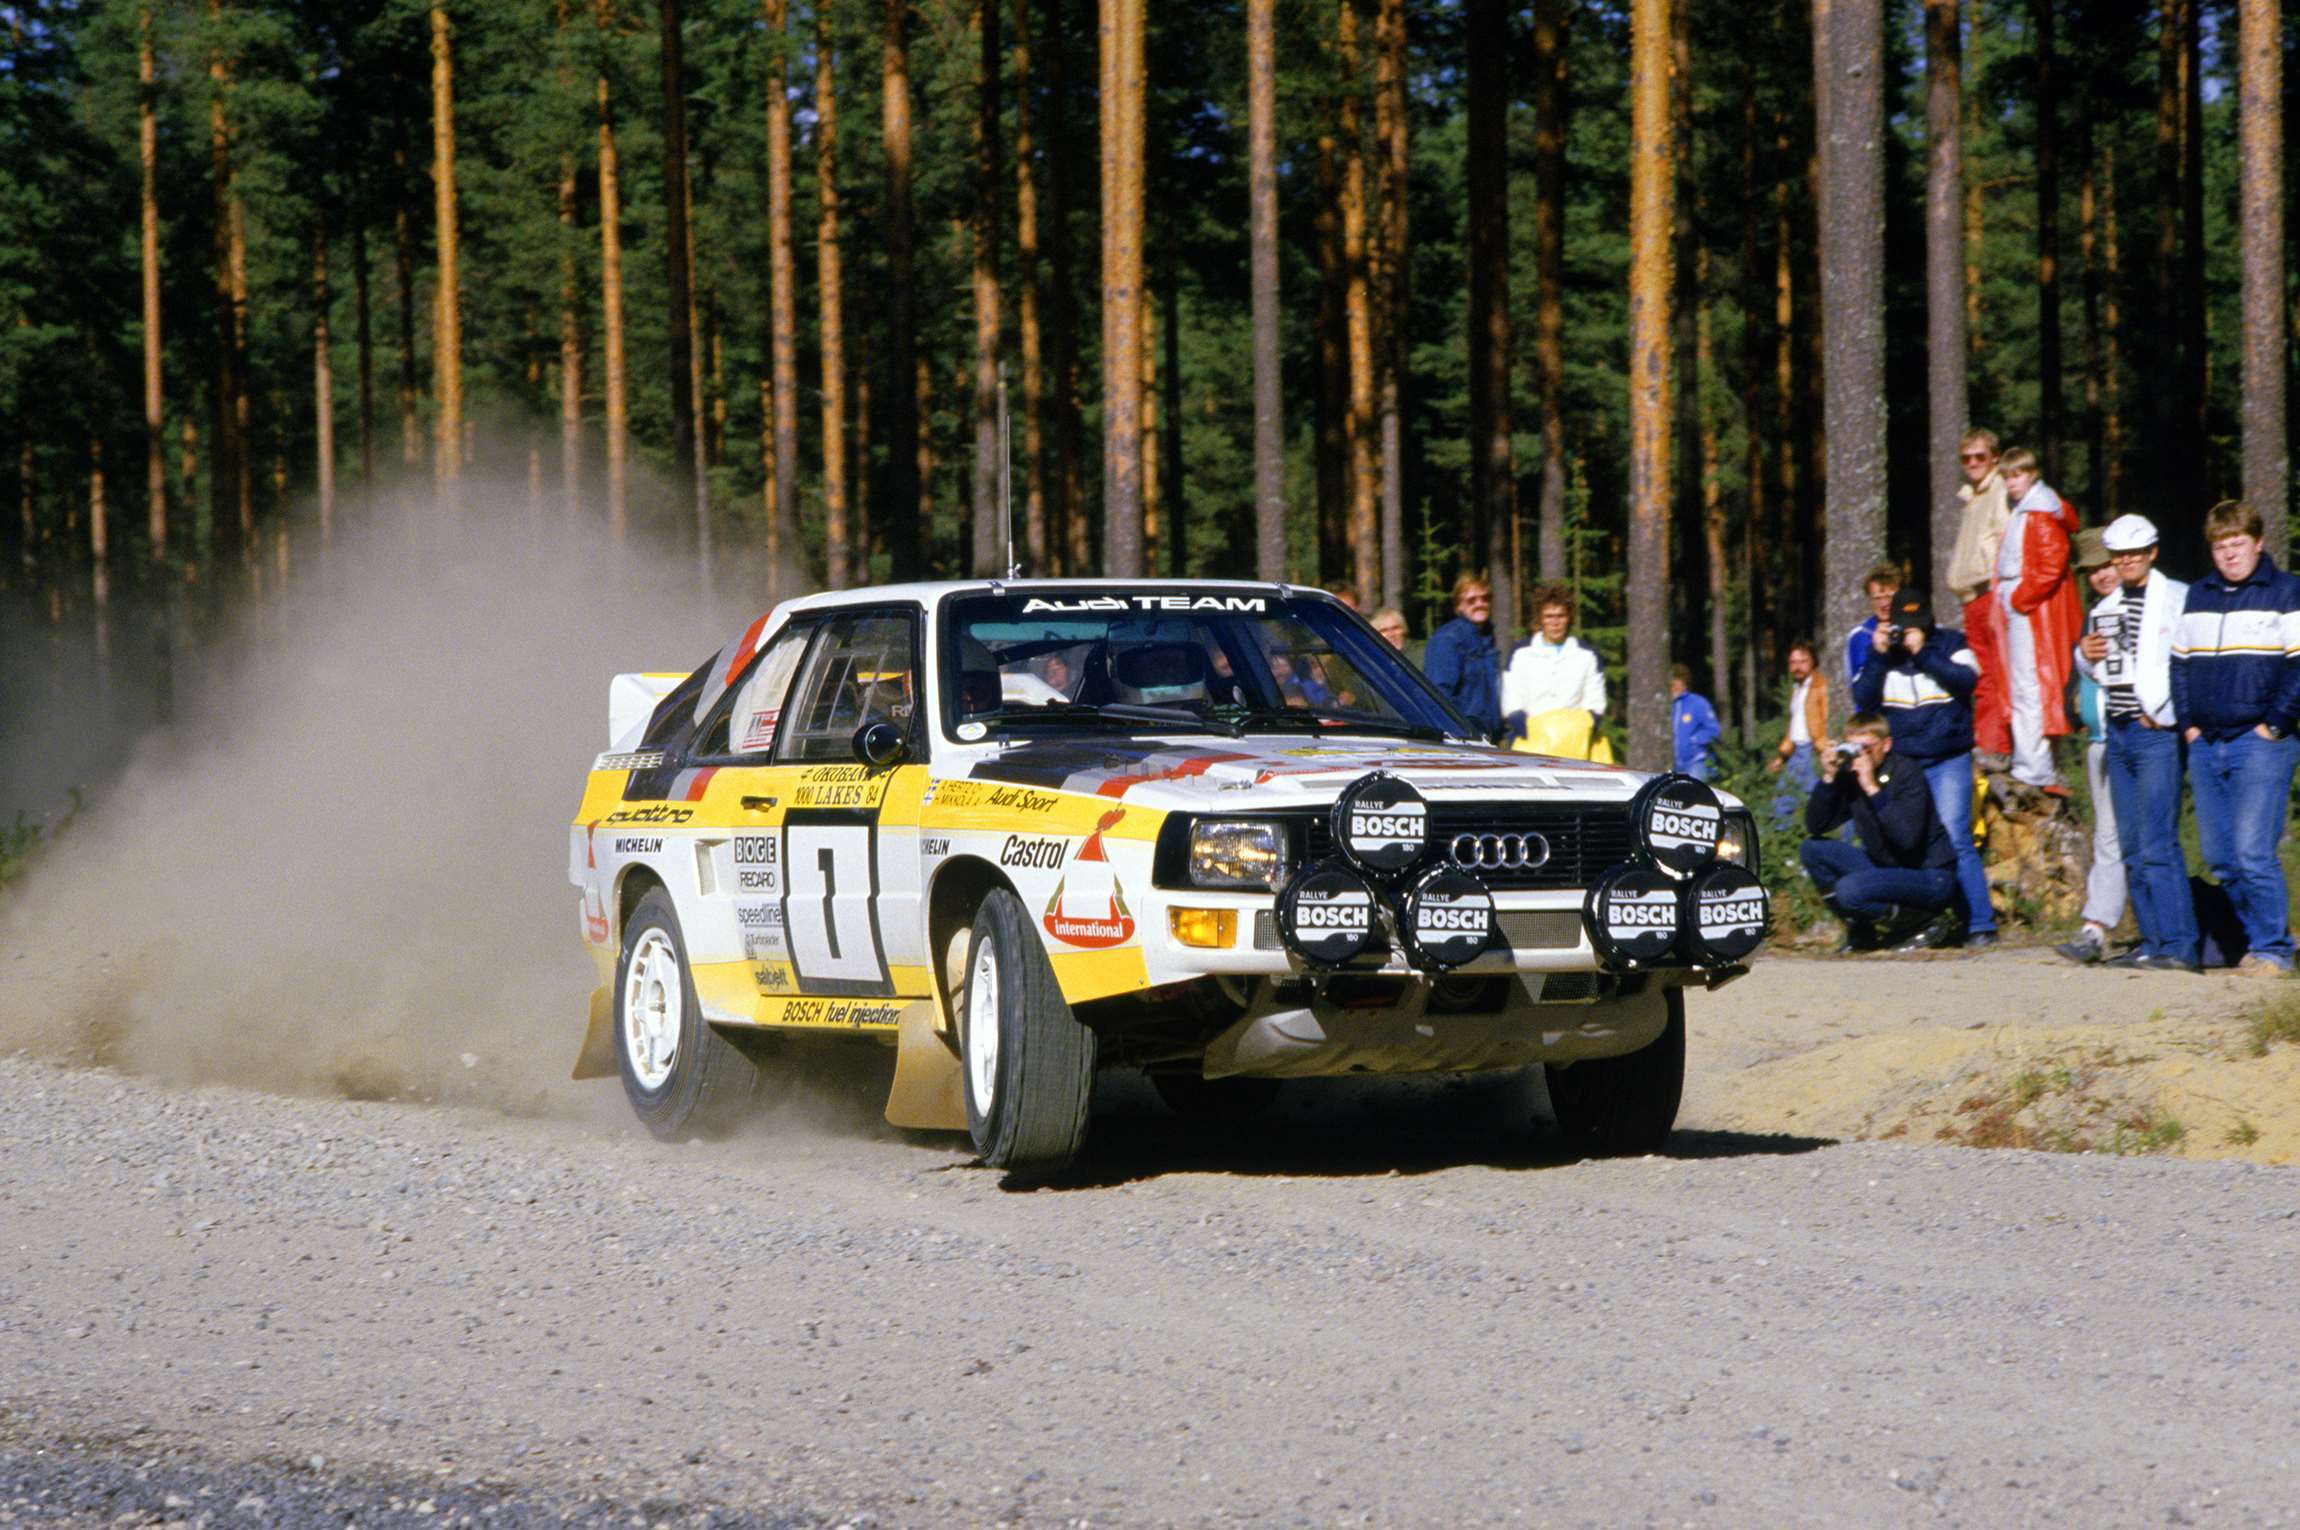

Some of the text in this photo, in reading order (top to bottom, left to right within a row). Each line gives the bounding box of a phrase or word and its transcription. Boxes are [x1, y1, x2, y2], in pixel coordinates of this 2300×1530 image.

[1132, 596, 1266, 612] TEAM
[815, 785, 863, 805] LAKES
[865, 785, 879, 804] 84
[984, 786, 1058, 813] Audi Sport
[1354, 800, 1384, 810] RALLYE
[1656, 798, 1684, 810] RALLYE
[606, 804, 694, 825] quattro
[1351, 816, 1424, 837] BOSCH
[1651, 811, 1717, 840] BOSCH
[615, 838, 664, 853] MICHELIN
[735, 837, 776, 863] BOGE
[1000, 834, 1070, 870] Castrol
[740, 871, 775, 888] RECARO
[818, 848, 842, 959] 1
[1300, 891, 1328, 900] RALLYE
[1422, 893, 1449, 903] RALLYE
[1611, 889, 1638, 899] RALLYE
[1701, 889, 1727, 899] RALLYE
[737, 904, 783, 926] speedline
[1296, 906, 1369, 927] BOSCH
[1417, 908, 1488, 930] BOSCH
[1608, 904, 1676, 925] BOSCH
[1699, 900, 1764, 925] BOSCH
[1055, 918, 1124, 939] international
[782, 1000, 901, 1029] BOSCH fuel injection
